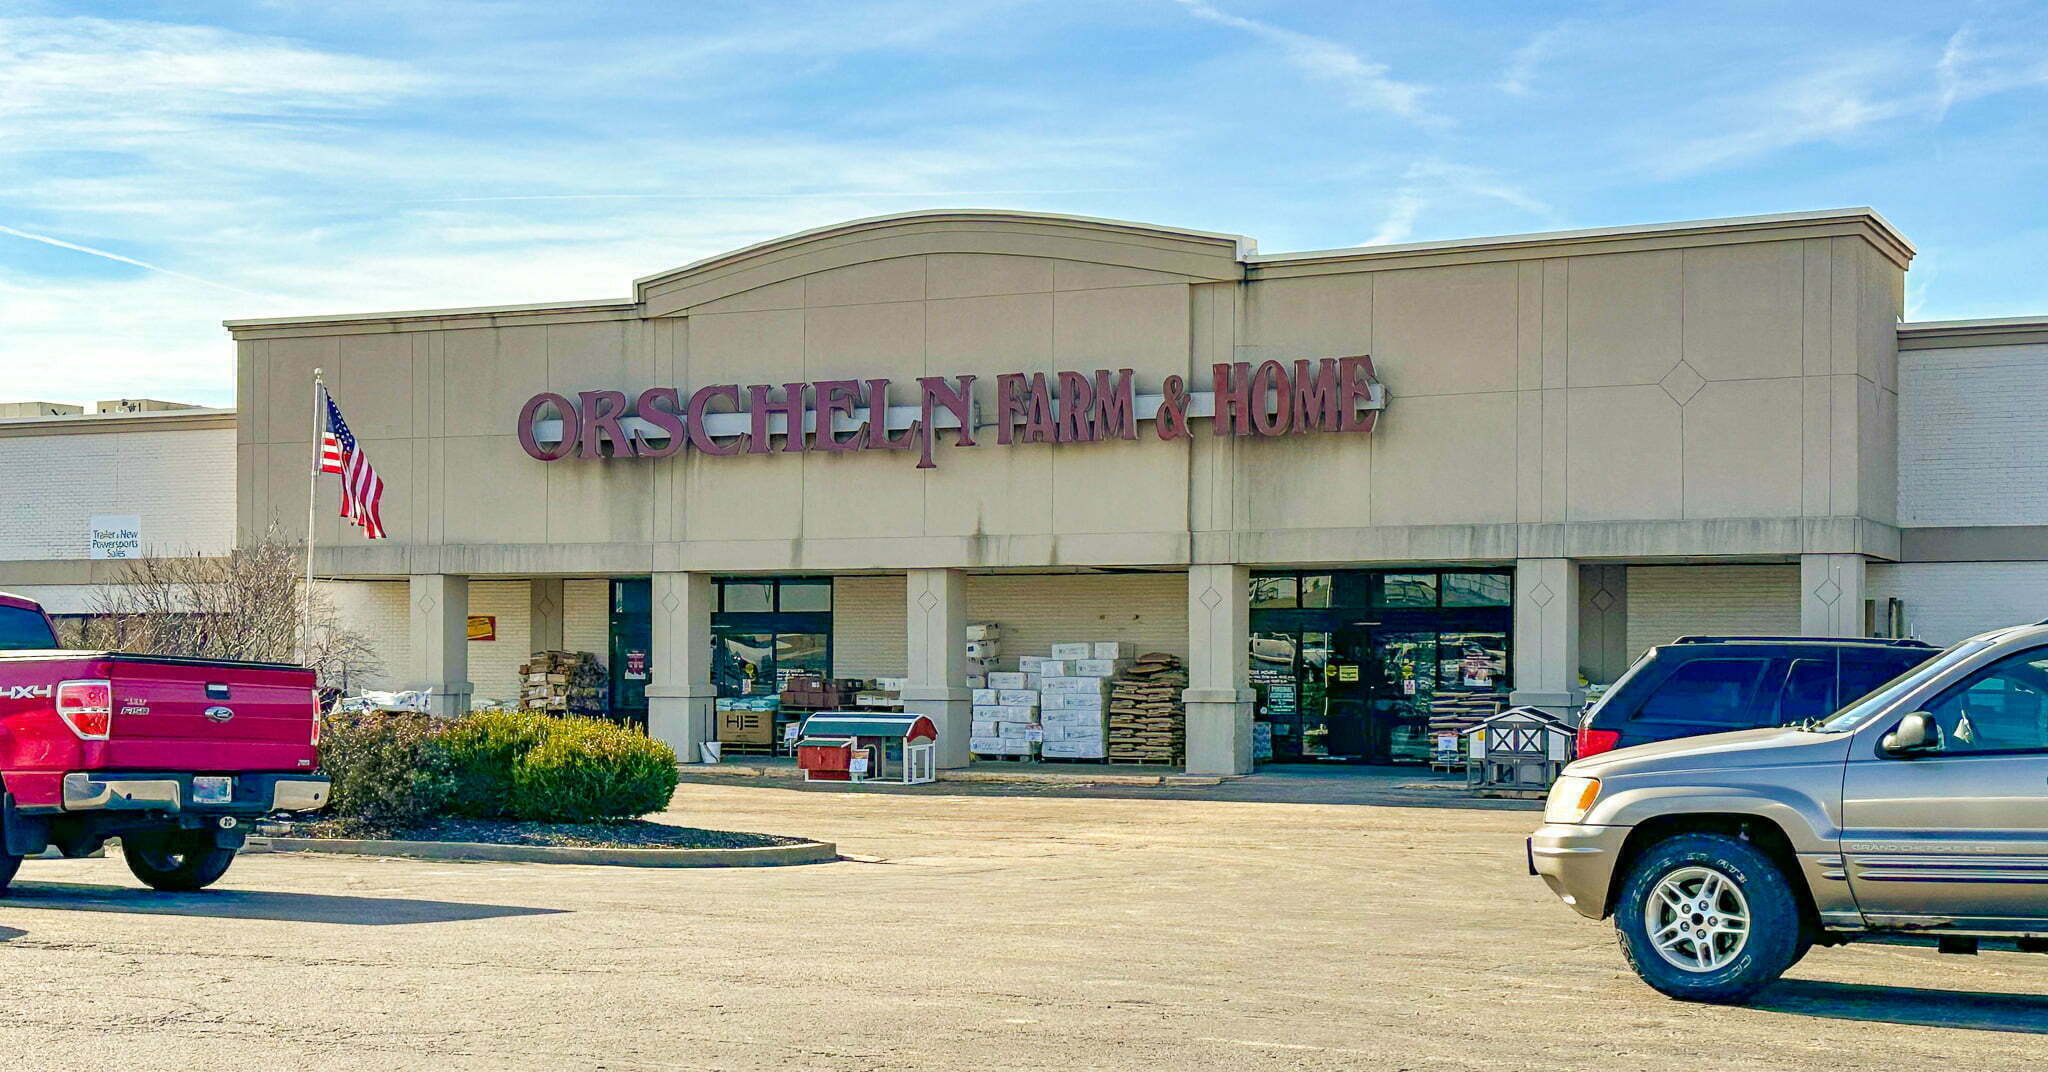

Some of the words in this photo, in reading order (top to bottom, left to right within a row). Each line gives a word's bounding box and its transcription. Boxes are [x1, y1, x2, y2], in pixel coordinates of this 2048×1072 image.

[517, 375, 977, 469] ORSCHELN
[996, 368, 1139, 444] FARM
[1156, 374, 1194, 441] &
[1212, 354, 1379, 437] HOME
[120, 529, 138, 539] New
[92, 539, 138, 549] Powersports
[726, 715, 759, 731] HJE
[1851, 842, 1898, 851] GRAND
